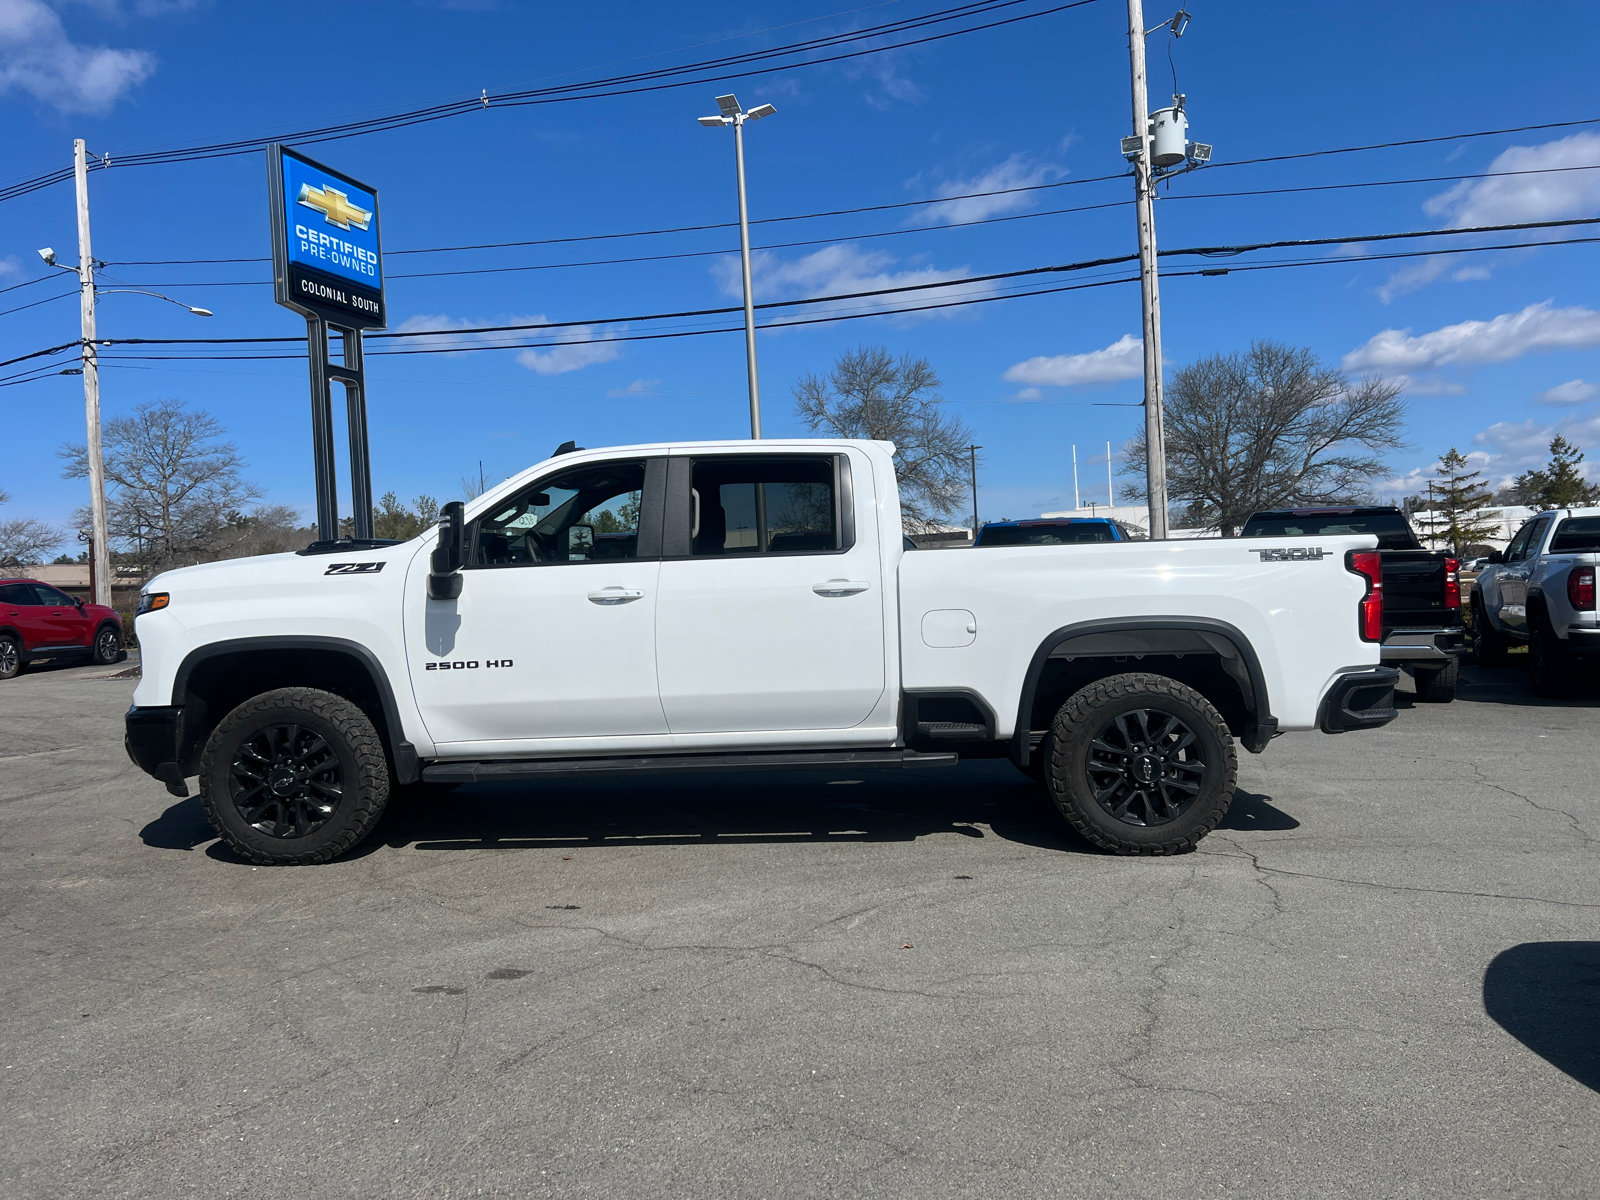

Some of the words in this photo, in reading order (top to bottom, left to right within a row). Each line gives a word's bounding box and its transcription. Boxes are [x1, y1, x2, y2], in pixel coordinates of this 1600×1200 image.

[295, 224, 377, 265] CERTIFIED
[301, 240, 375, 276] PRE-OWNED
[301, 279, 348, 304] COLONIAL
[352, 295, 379, 313] SOUTH
[324, 561, 387, 576] Z71
[425, 660, 479, 671] 2500
[486, 659, 514, 669] HD
